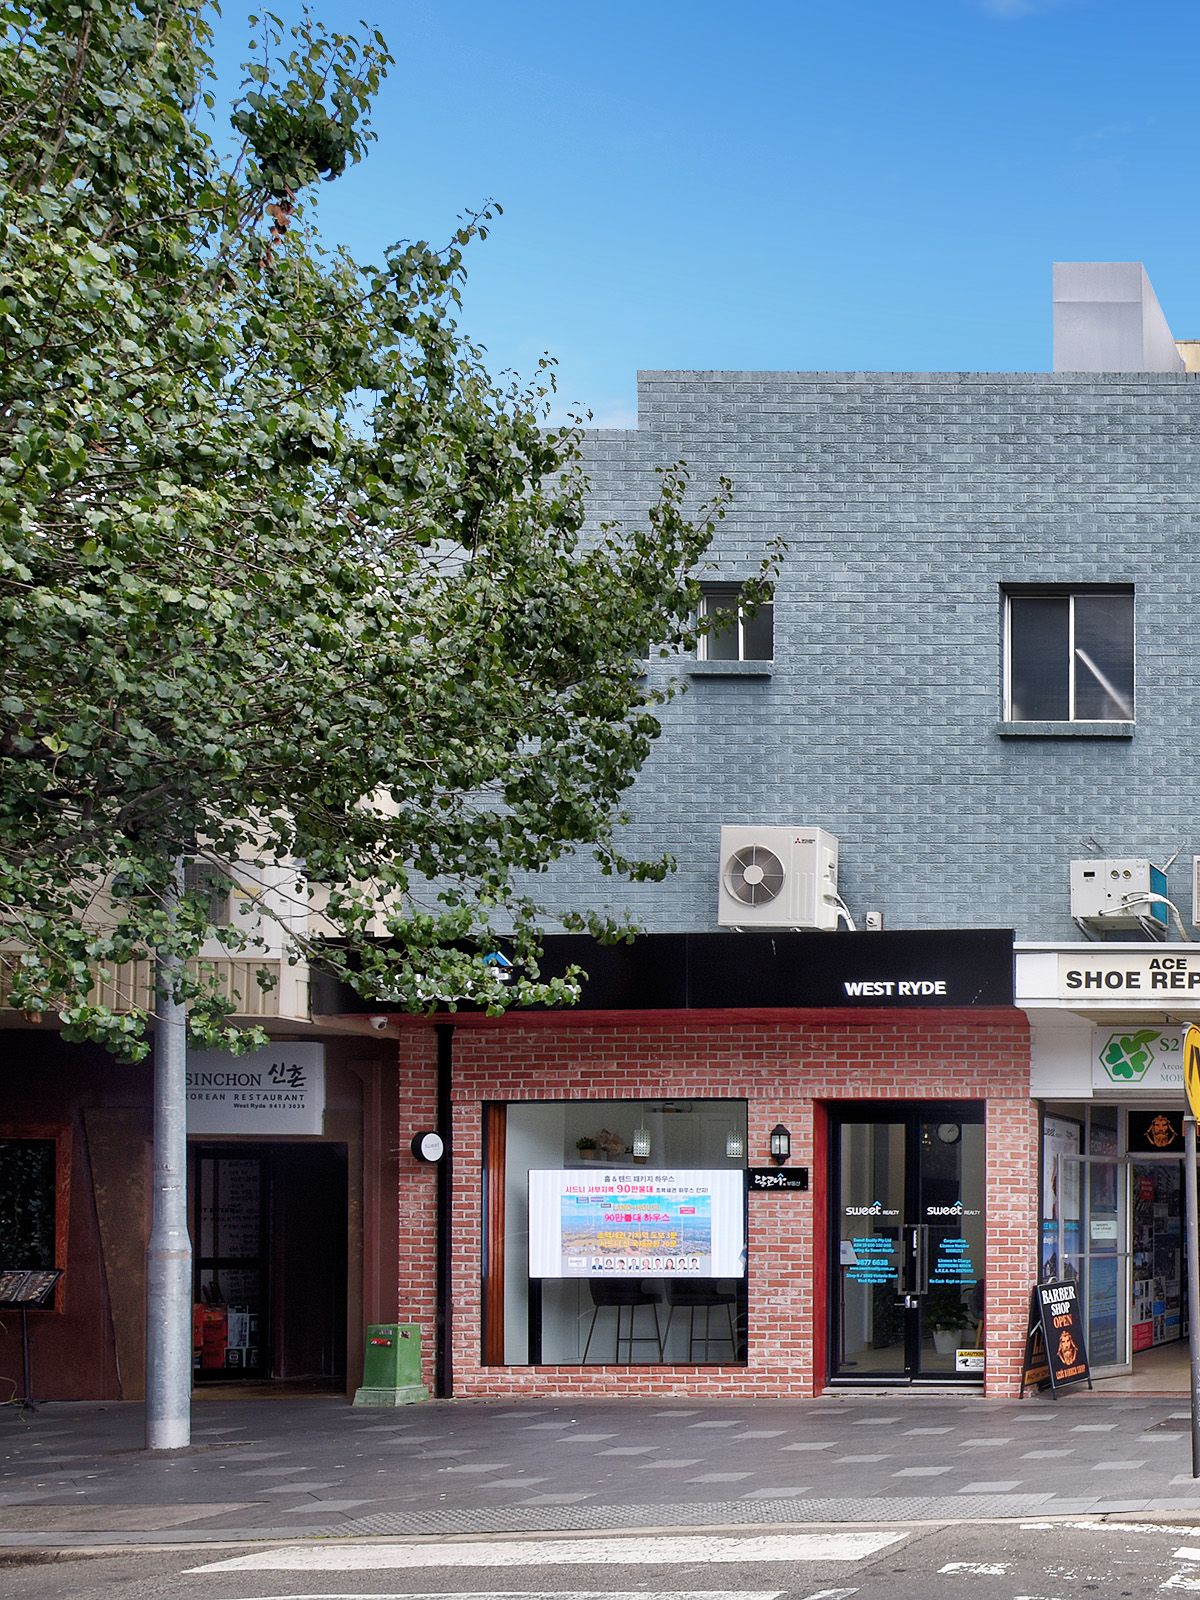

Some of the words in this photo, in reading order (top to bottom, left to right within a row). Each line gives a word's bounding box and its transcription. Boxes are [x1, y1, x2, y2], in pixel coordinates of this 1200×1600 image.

[1149, 958, 1188, 970] ACE
[1066, 970, 1141, 989] SHOE
[844, 982, 895, 996] WEST
[898, 981, 947, 995] RYDE
[1159, 1038, 1179, 1051] S2
[1160, 1062, 1185, 1070] Arca
[186, 1072, 262, 1087] SINCHON
[1160, 1074, 1185, 1082] MOB
[655, 1175, 675, 1183] 하우스
[565, 1186, 585, 1194] 시드니
[845, 1205, 881, 1215] sweet
[926, 1205, 963, 1215] sweet
[644, 1213, 671, 1222] 하우스
[1041, 1285, 1076, 1305] BARBER
[1050, 1301, 1071, 1316] SHOP
[1053, 1314, 1073, 1329] OPEN
